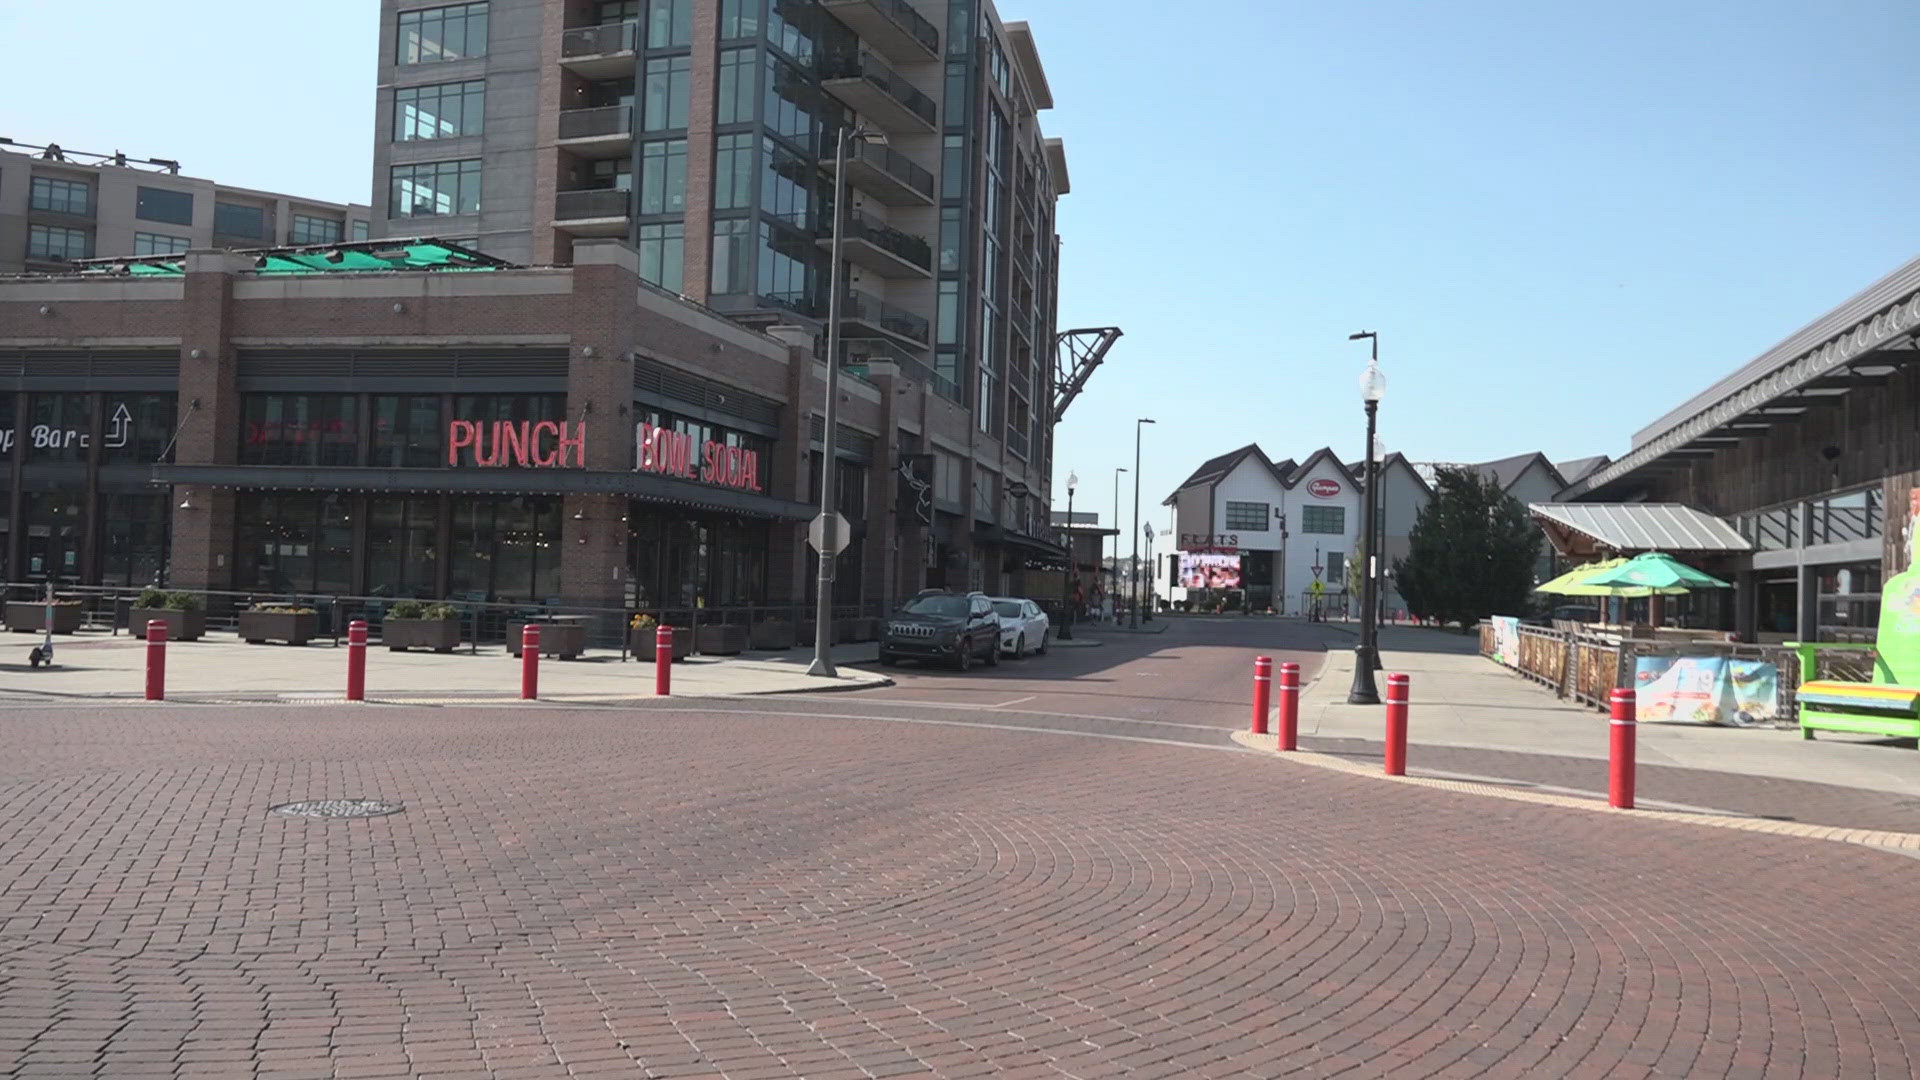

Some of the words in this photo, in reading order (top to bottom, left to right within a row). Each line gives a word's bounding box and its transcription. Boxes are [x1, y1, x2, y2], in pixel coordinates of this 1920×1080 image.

[31, 424, 76, 448] Bar
[449, 420, 586, 468] PUNCH
[639, 422, 697, 479] BOWL
[702, 440, 762, 491] SOCIAL
